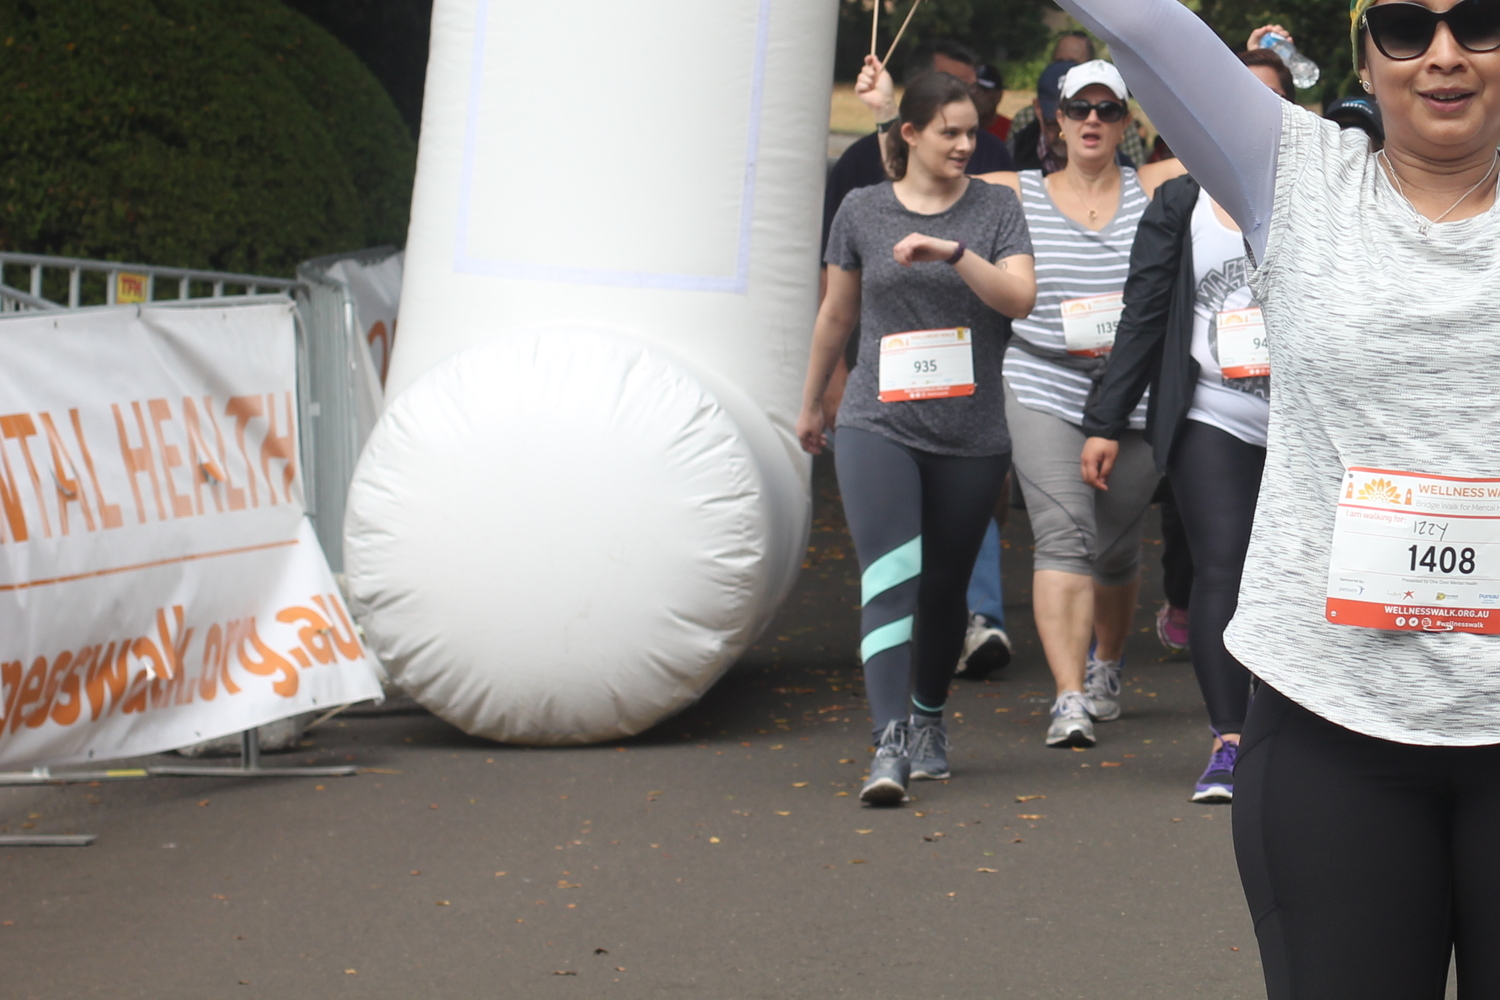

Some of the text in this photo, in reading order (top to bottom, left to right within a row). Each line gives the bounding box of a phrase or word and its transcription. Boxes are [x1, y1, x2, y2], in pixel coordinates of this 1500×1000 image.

[914, 359, 937, 373] 935
[111, 391, 293, 524] HEALTH
[1418, 483, 1485, 498] WELLNESS
[1416, 500, 1440, 510] Bridge
[1441, 502, 1458, 510] Walk
[1472, 503, 1496, 511] Mental
[1363, 511, 1392, 523] walking
[1393, 514, 1407, 523] for:
[1408, 544, 1476, 575] 1408
[1384, 605, 1490, 619] WELLNESSWALK.ORG.AU
[1436, 620, 1484, 628] #wellnesswalk
